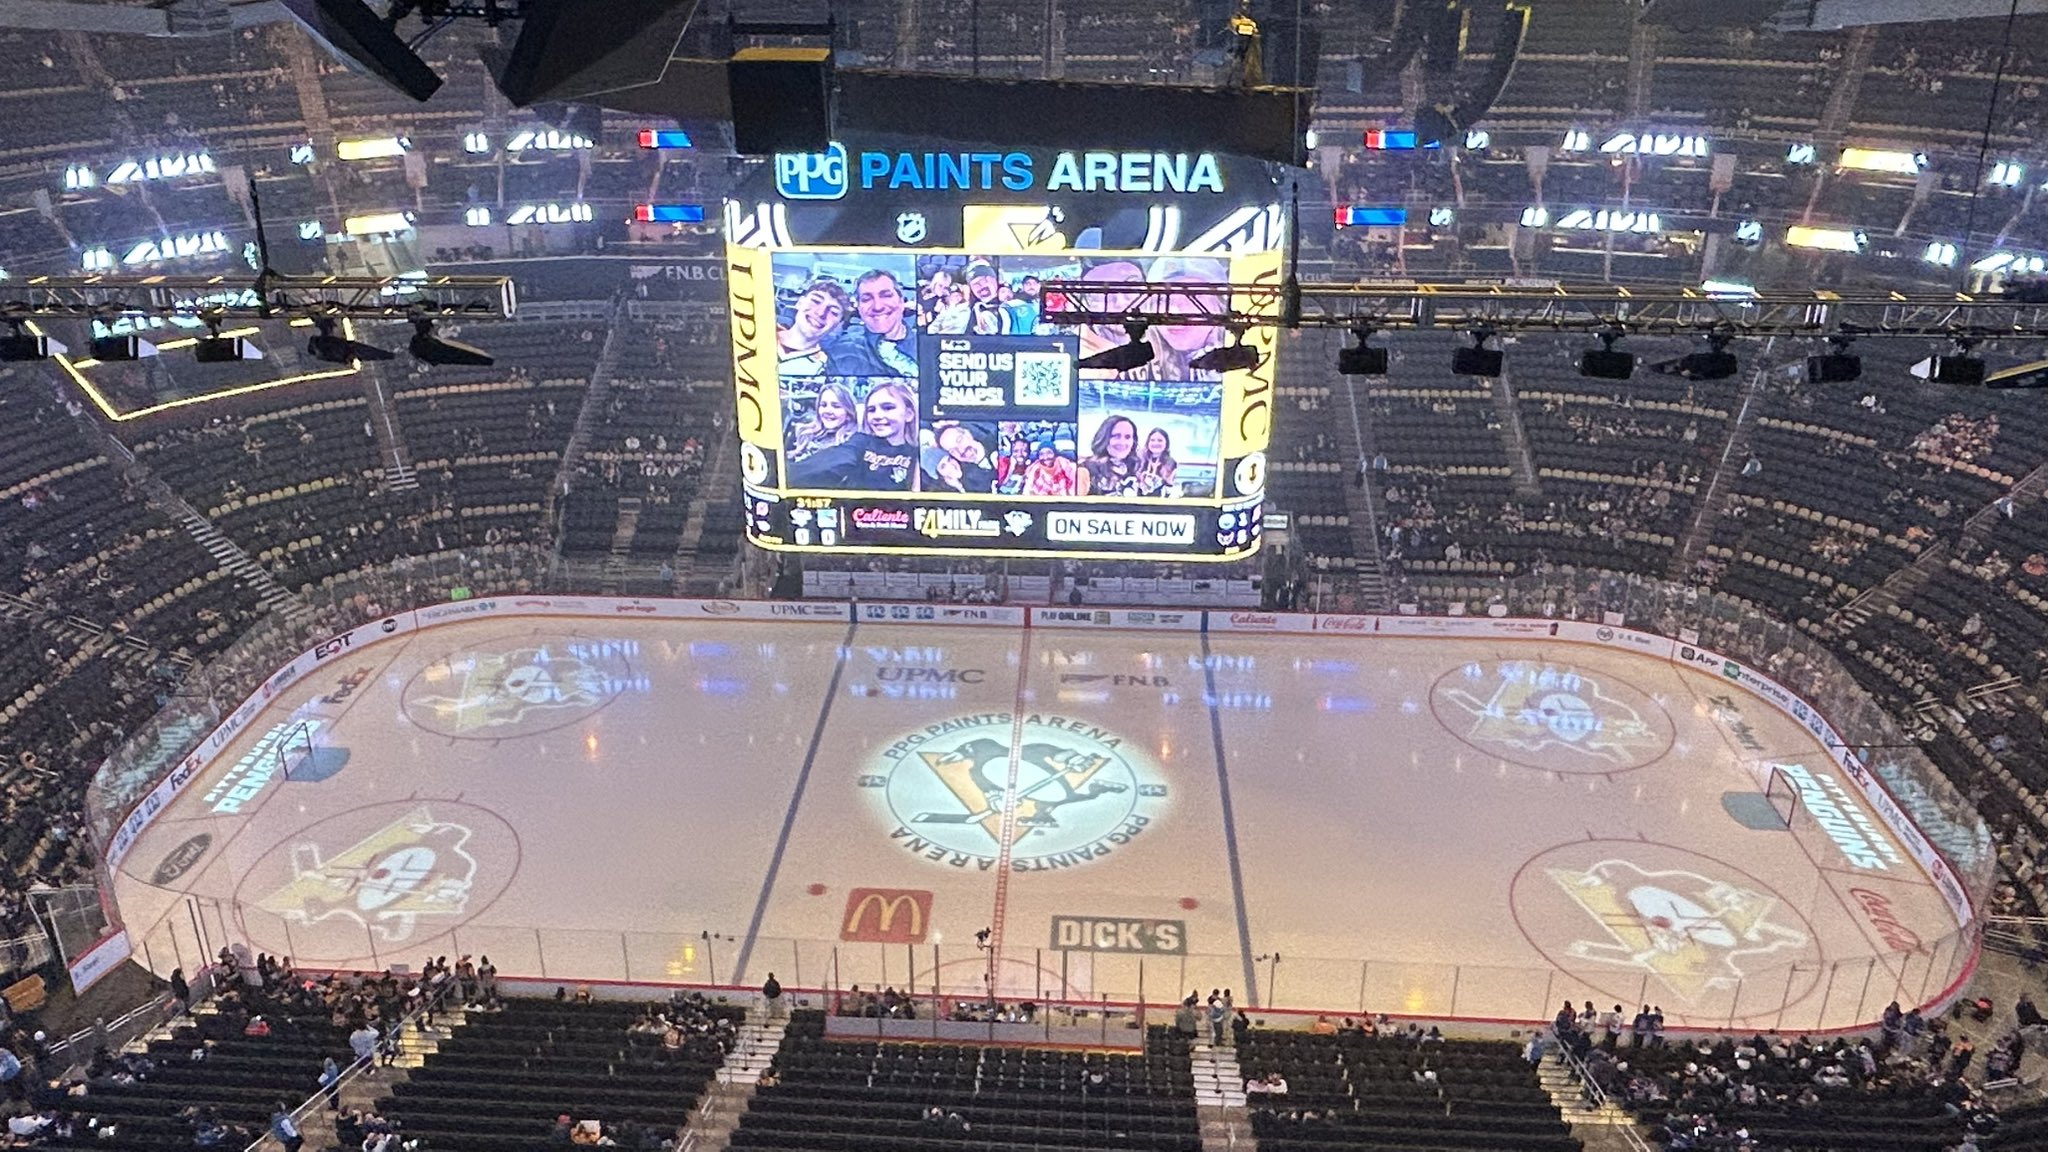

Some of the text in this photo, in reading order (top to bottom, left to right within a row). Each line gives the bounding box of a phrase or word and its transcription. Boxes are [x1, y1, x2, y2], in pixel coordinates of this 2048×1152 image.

[780, 152, 1226, 193] PPG PAINTS ARENA
[731, 262, 763, 433] UPMC
[939, 353, 1014, 371] SEND US
[939, 370, 988, 387] YOUR
[939, 387, 1005, 404] SNAPS!
[1055, 518, 1187, 537] ON SALE NOW
[770, 604, 812, 616] UPMC
[1058, 612, 1091, 621] ONLINE
[1230, 613, 1278, 625] Caliente
[314, 631, 354, 661] EQT
[875, 667, 986, 685] UPMC
[211, 717, 243, 749] UPMC
[884, 713, 1122, 760] PPG PAINTS ARENA
[169, 753, 203, 791] FedEx
[1843, 750, 1869, 788] FedEx
[1773, 763, 1889, 870] PENGUINS
[1815, 773, 1905, 864] PITTSBURGH
[889, 813, 1150, 873] PPG PAINTS ARENA
[1057, 919, 1181, 953] DICK'S
